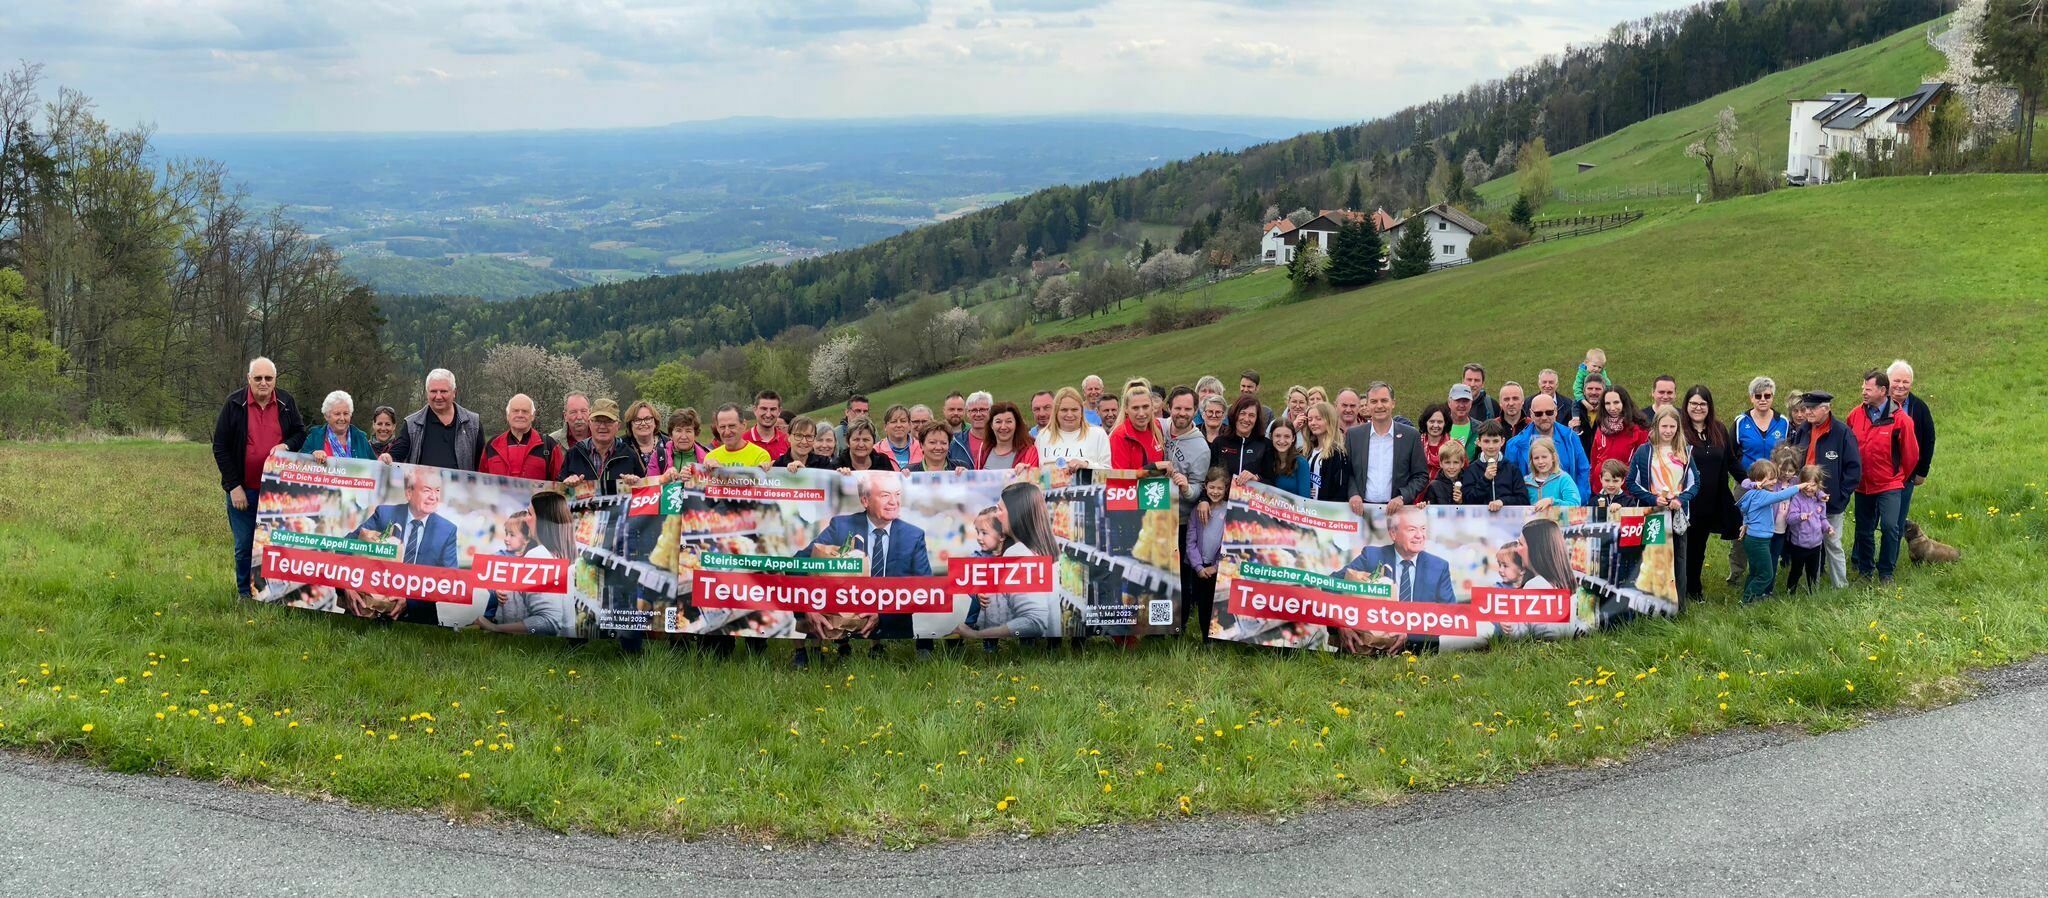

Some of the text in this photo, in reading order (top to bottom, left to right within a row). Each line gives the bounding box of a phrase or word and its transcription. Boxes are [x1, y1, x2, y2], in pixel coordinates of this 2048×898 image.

[276, 461, 301, 471] LH-Stv.
[302, 465, 326, 473] ANTON
[296, 473, 312, 481] Dich
[313, 475, 321, 483] da
[331, 476, 352, 486] diesen
[699, 476, 726, 484] LH-Stv.
[631, 492, 660, 508] SPÖ
[723, 487, 740, 495] Dich
[743, 488, 751, 496] da
[764, 489, 791, 498] diesen
[793, 490, 822, 498] Zeiten.
[1107, 486, 1137, 500] SPÖ
[1252, 501, 1356, 531] Für Dich da in diesen Zeiten.
[1269, 499, 1294, 511] ANTON
[1296, 506, 1317, 516] LANG
[1621, 523, 1643, 537] SPÖ
[272, 531, 394, 555] Steirischer Appell zum 1. Mai:
[704, 555, 860, 570] Steirischer Appell zum 1. Mai:
[267, 551, 466, 597] Teuerung stoppen
[477, 560, 560, 586] JETZT!
[956, 562, 1044, 586] JETZT!
[1243, 564, 1389, 595] Steirischer Appell zum 1. Mai:
[700, 577, 944, 610] Teuerung stoppen
[1238, 585, 1469, 631] Teuerung stoppen
[1478, 593, 1563, 616] JETZT!
